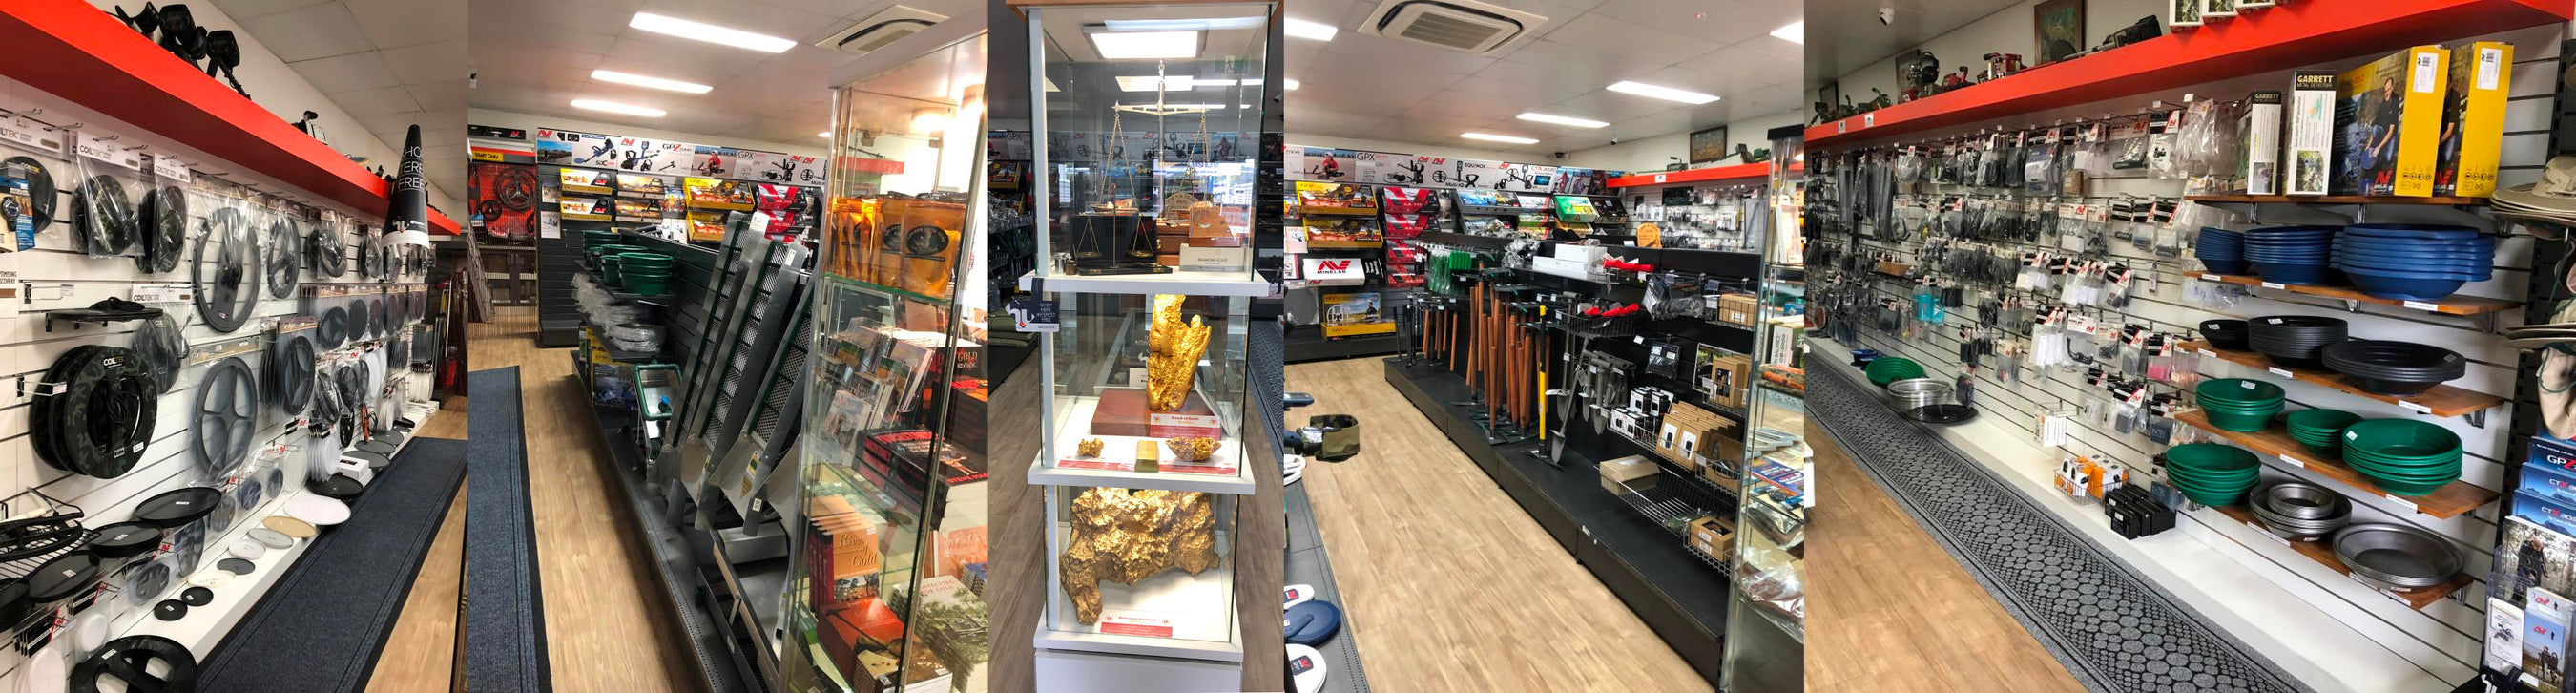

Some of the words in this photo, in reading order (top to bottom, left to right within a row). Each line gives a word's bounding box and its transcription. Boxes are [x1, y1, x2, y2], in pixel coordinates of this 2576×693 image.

[2297, 74, 2334, 83] GARRETT
[79, 145, 102, 158] COILTEK
[737, 150, 755, 159] GPX
[1356, 152, 1375, 161] GPX
[398, 177, 425, 191] FREE
[103, 355, 125, 367] COILTEK
[840, 534, 866, 548] River
[860, 544, 869, 555] of
[852, 552, 878, 567] Gold
